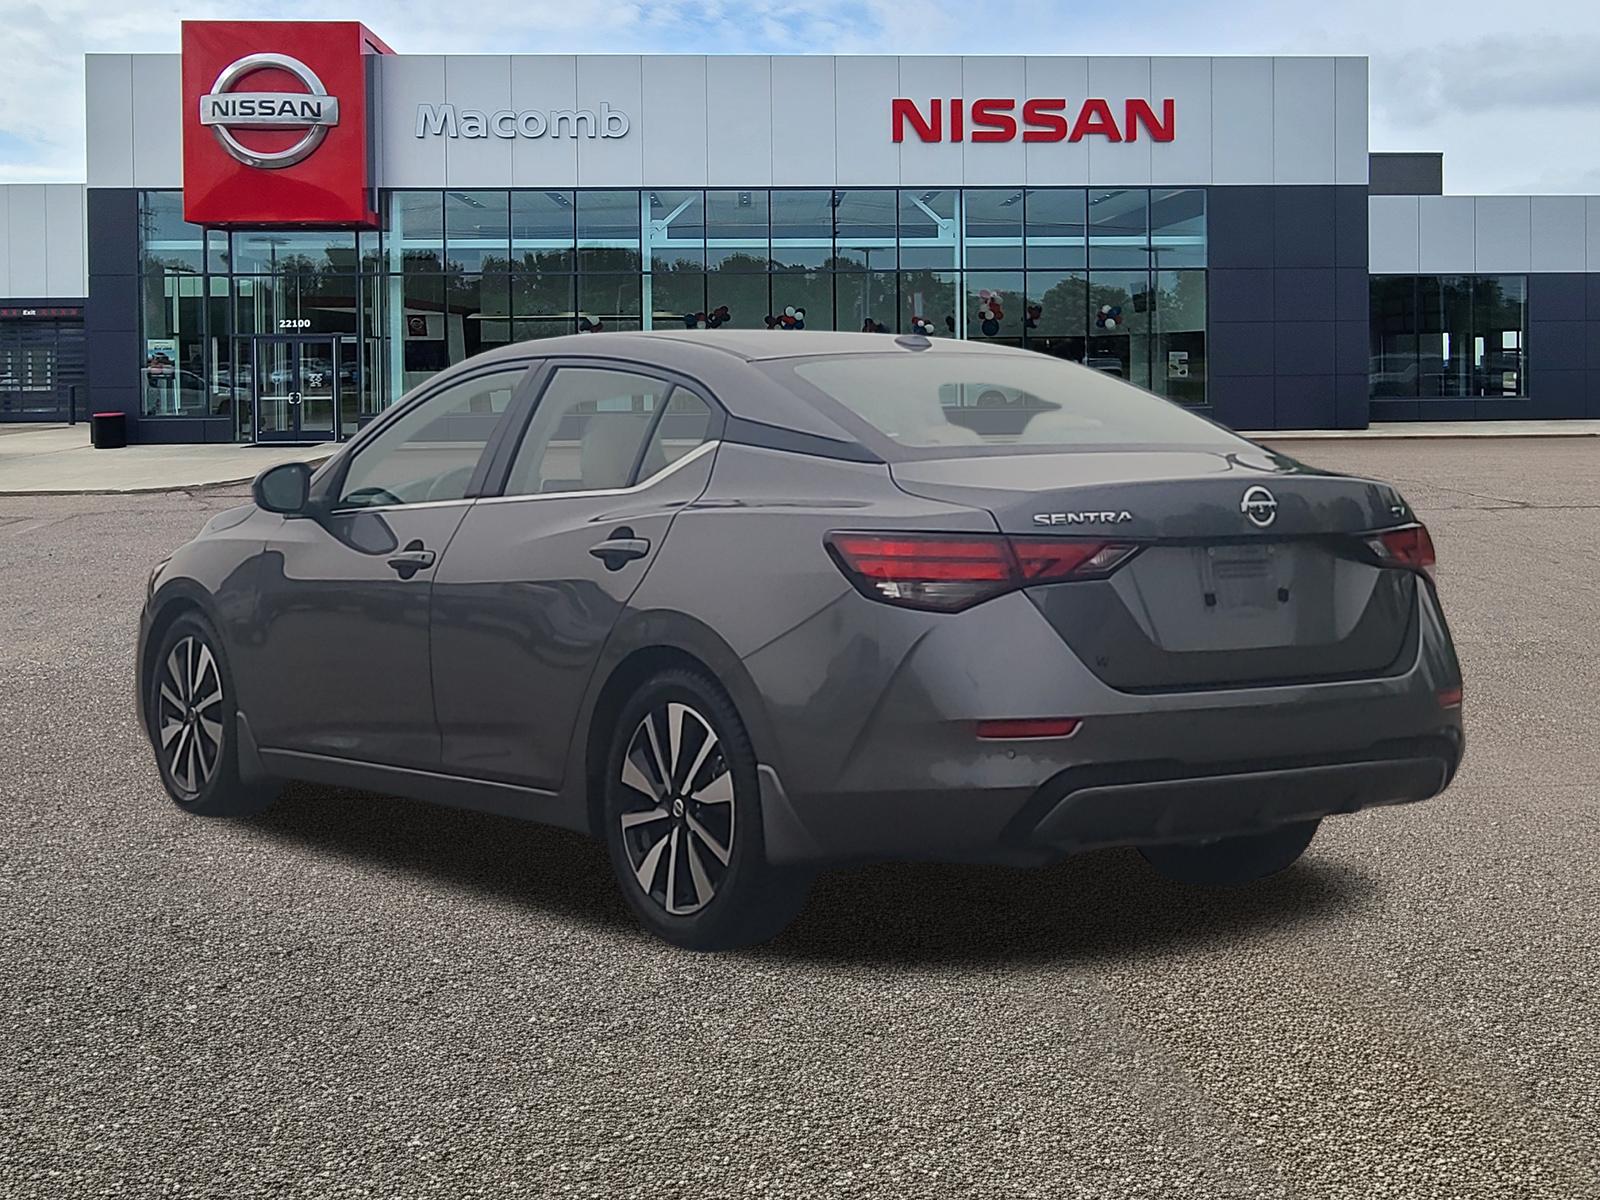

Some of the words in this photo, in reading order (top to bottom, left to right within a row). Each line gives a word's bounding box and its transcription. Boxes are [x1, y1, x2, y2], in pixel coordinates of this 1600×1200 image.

[211, 100, 322, 117] NISSAN
[415, 101, 630, 138] Macomb
[892, 98, 1175, 142] NISSAN
[279, 319, 311, 328] 22100
[1033, 511, 1132, 526] SENTRA
